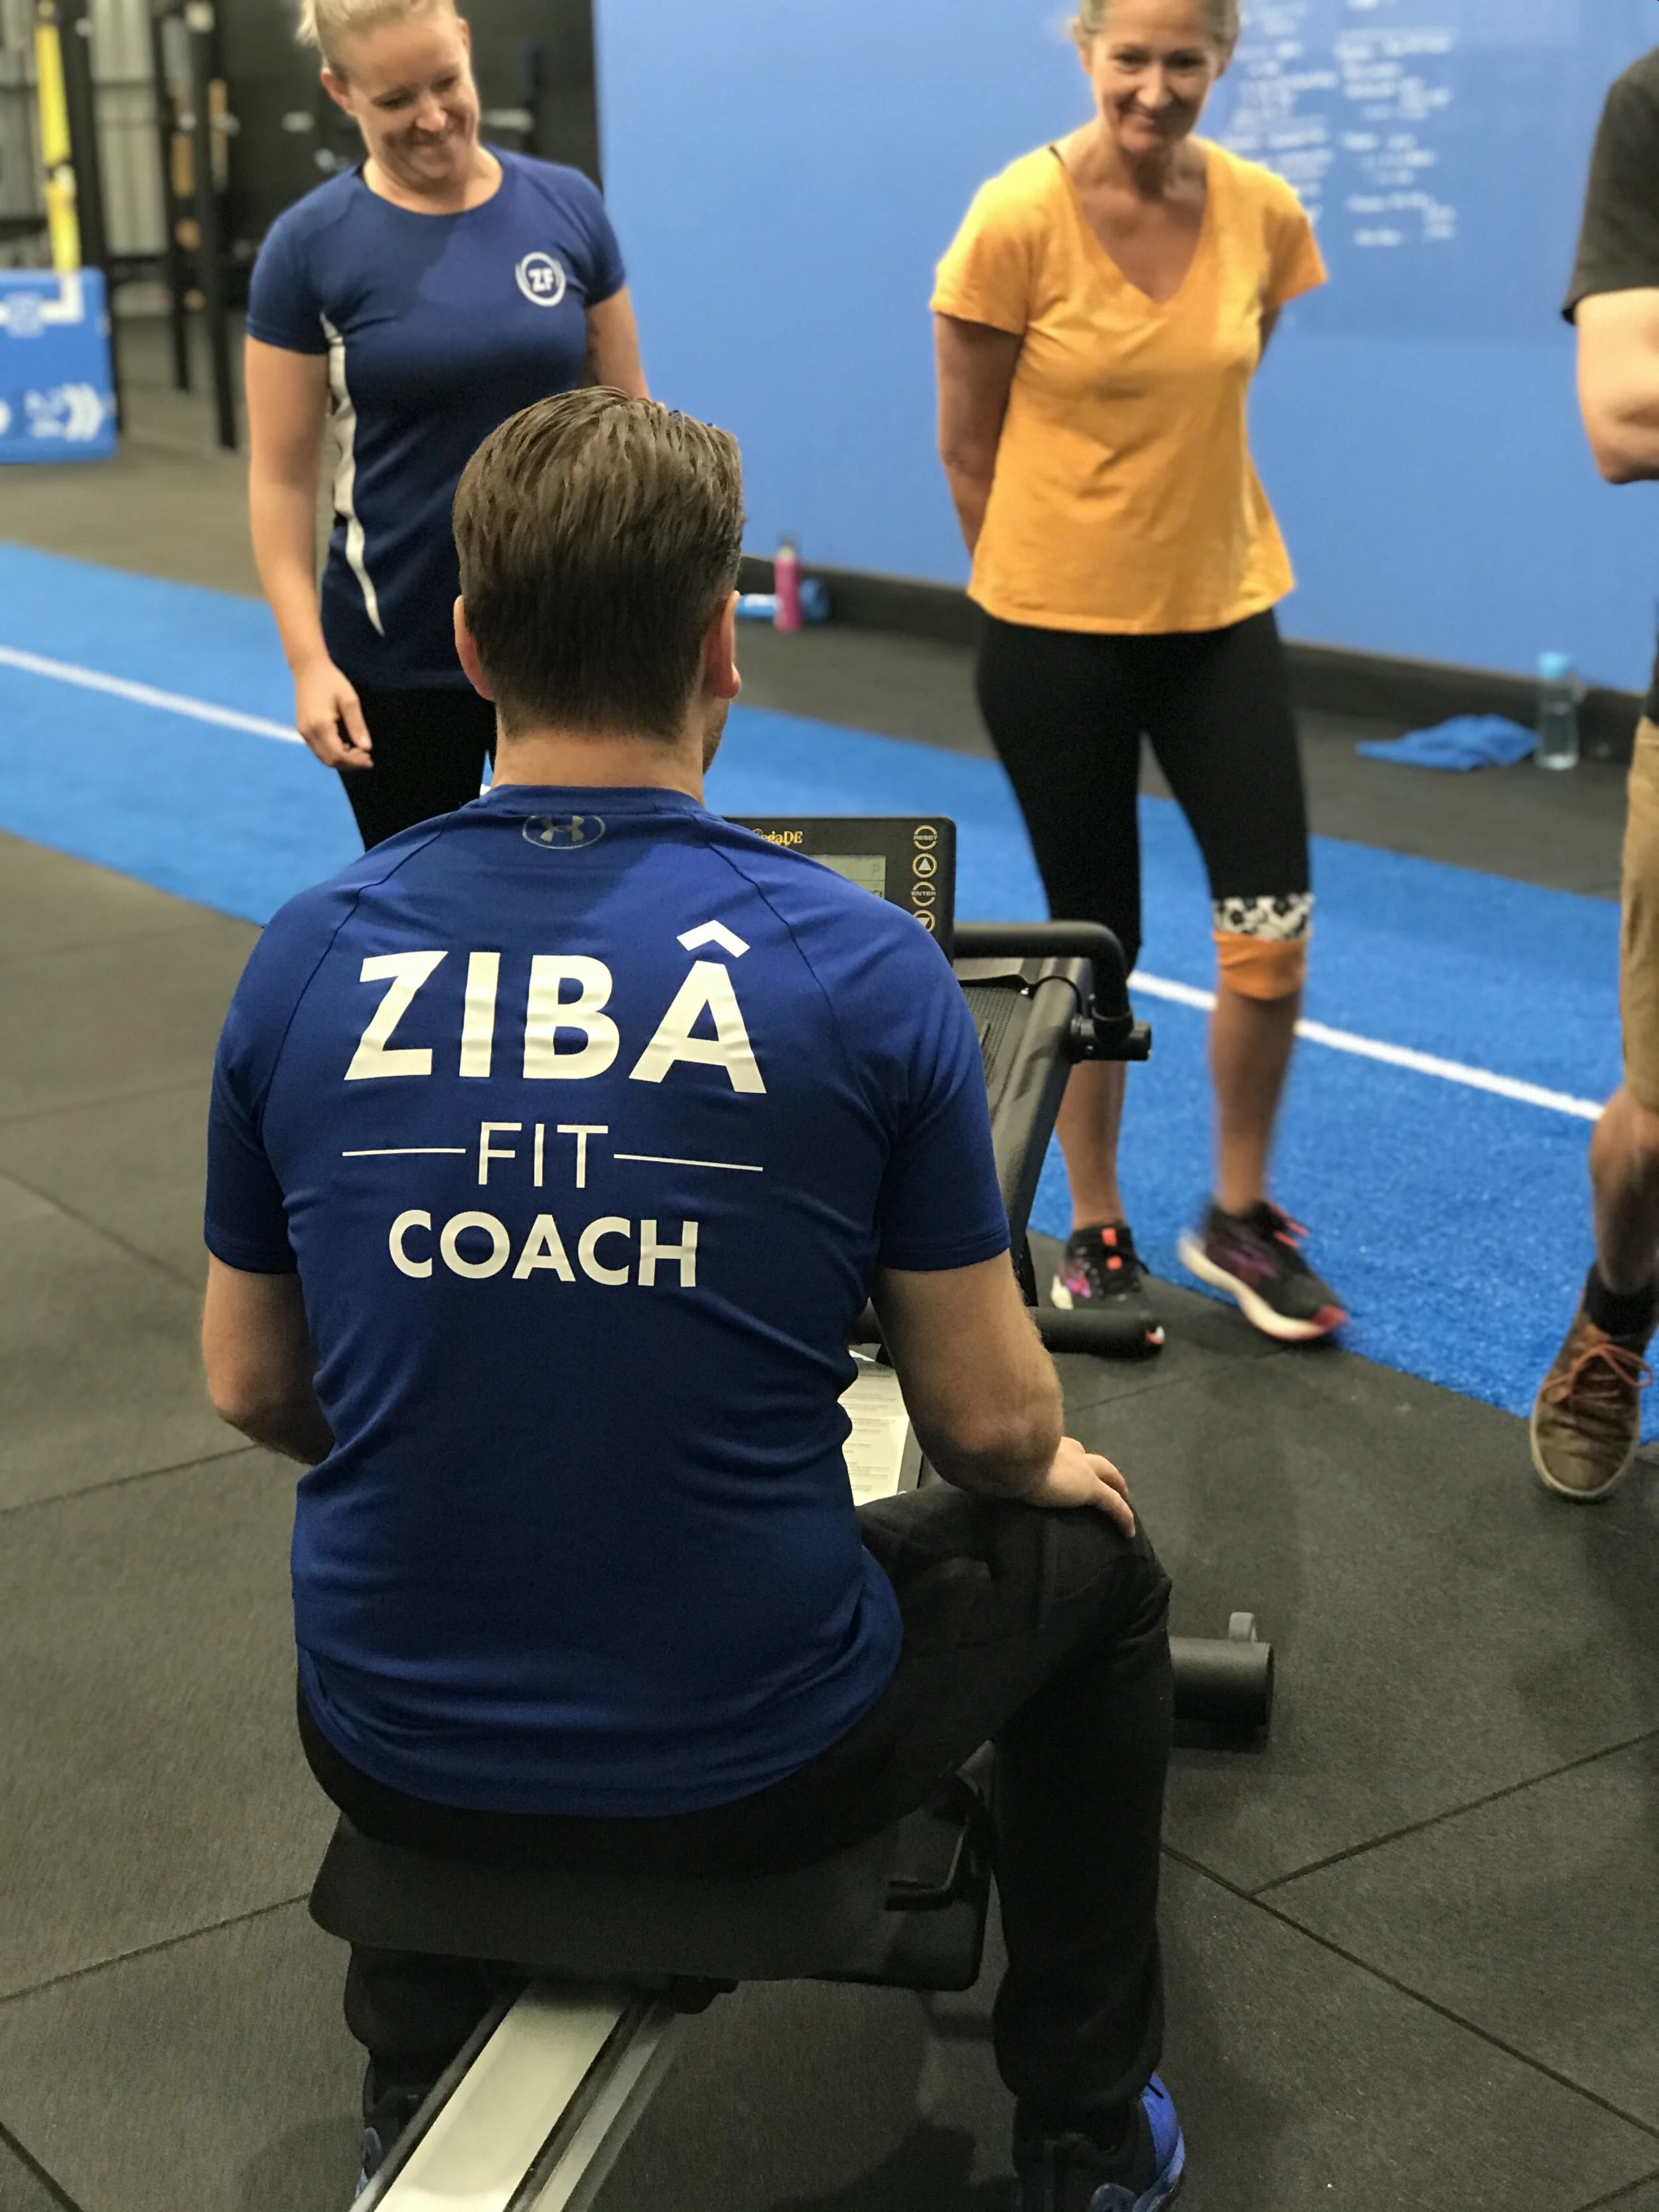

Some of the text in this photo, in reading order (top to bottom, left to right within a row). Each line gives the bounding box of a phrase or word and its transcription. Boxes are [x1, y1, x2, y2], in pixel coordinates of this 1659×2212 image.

[529, 268, 553, 291] ZF
[343, 919, 767, 1094] ZIBÂ
[478, 1122, 609, 1189] FIT
[388, 1209, 699, 1288] COACH
